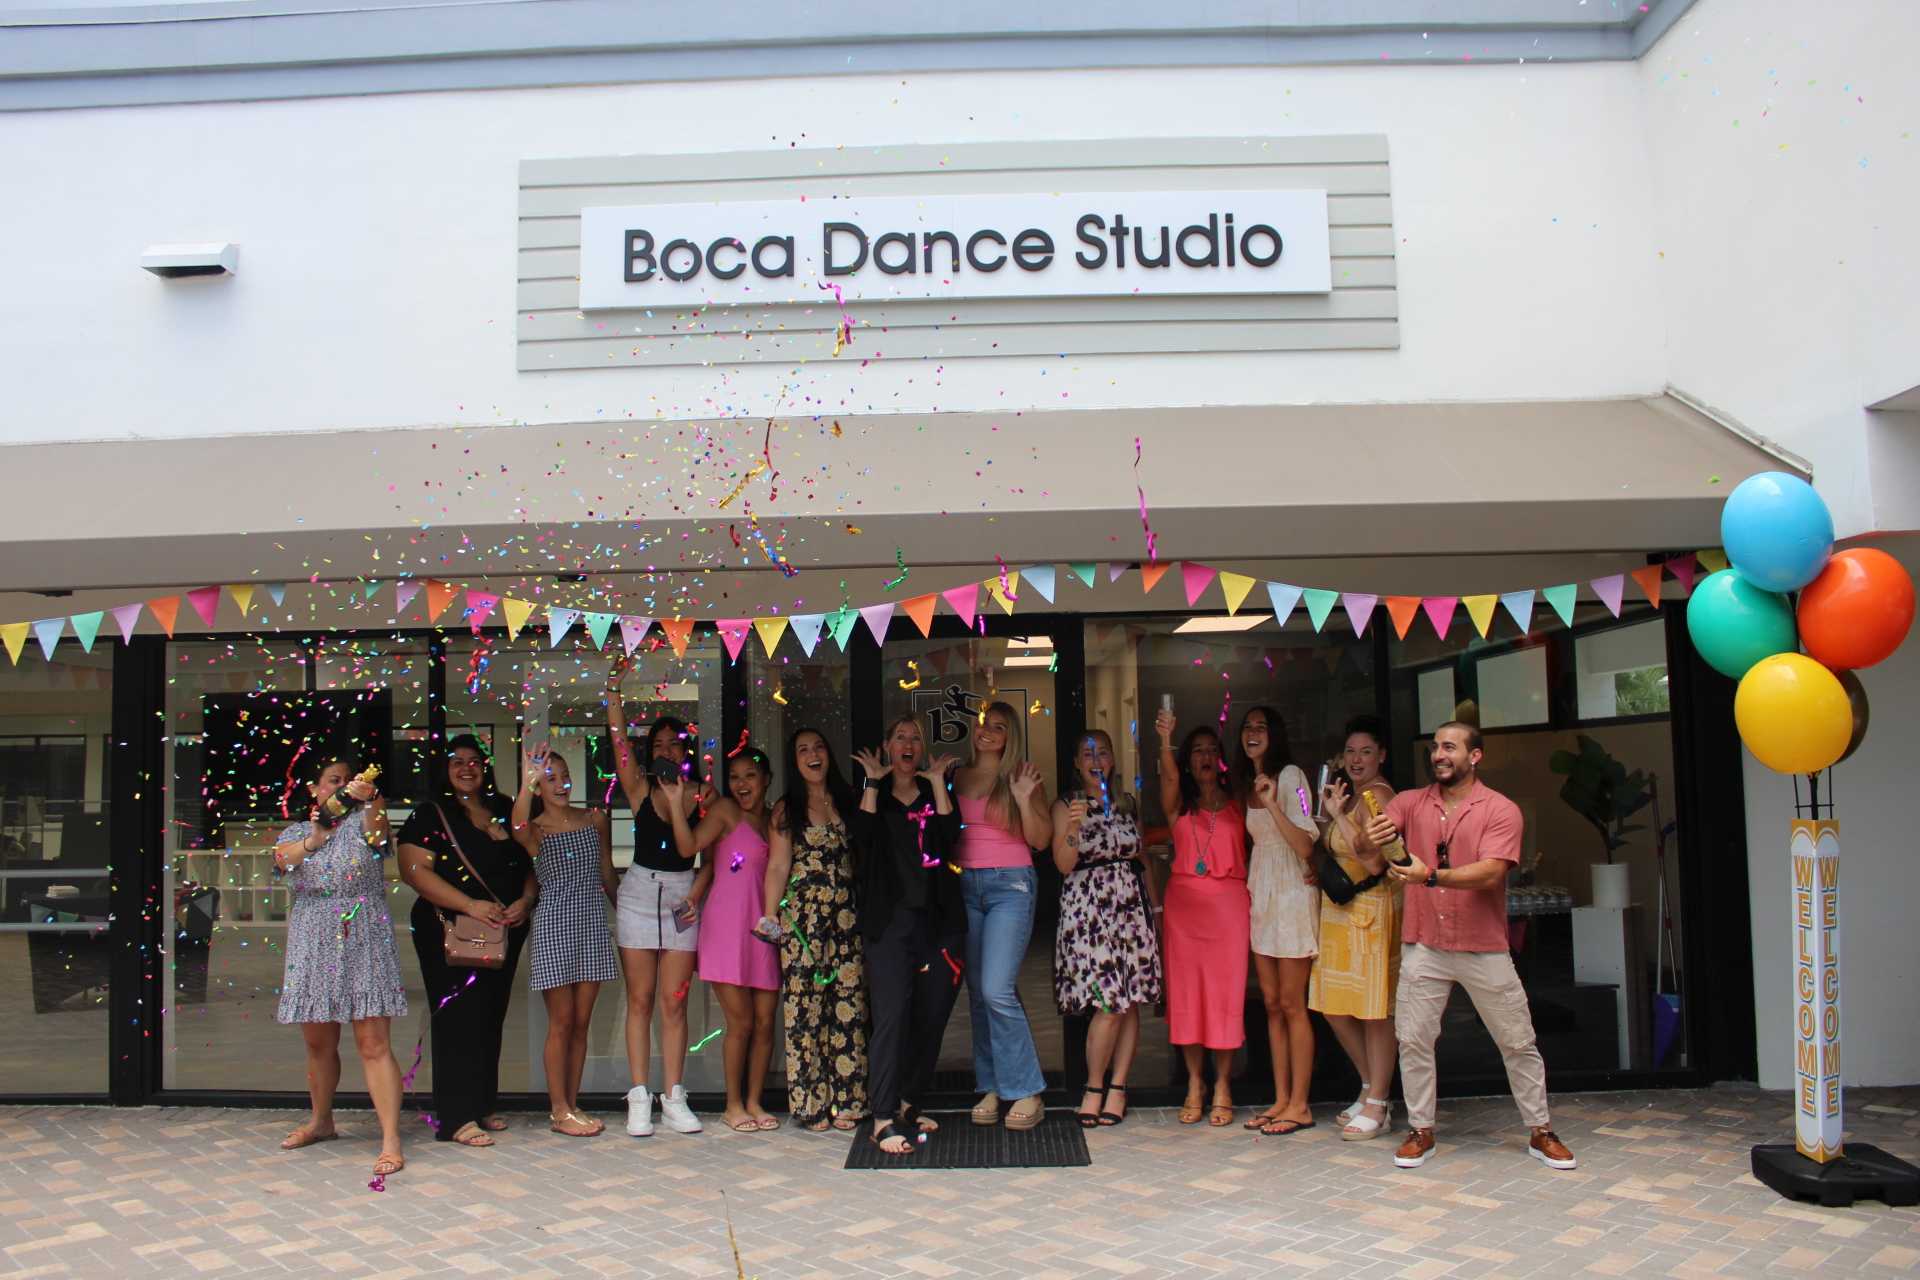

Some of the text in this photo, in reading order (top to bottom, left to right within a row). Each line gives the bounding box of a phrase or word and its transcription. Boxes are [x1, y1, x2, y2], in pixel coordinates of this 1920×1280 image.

[624, 212, 1284, 283] Boca Dance Studio
[1793, 854, 1816, 1116] WELCOME
[1817, 854, 1840, 1117] WELCOME
